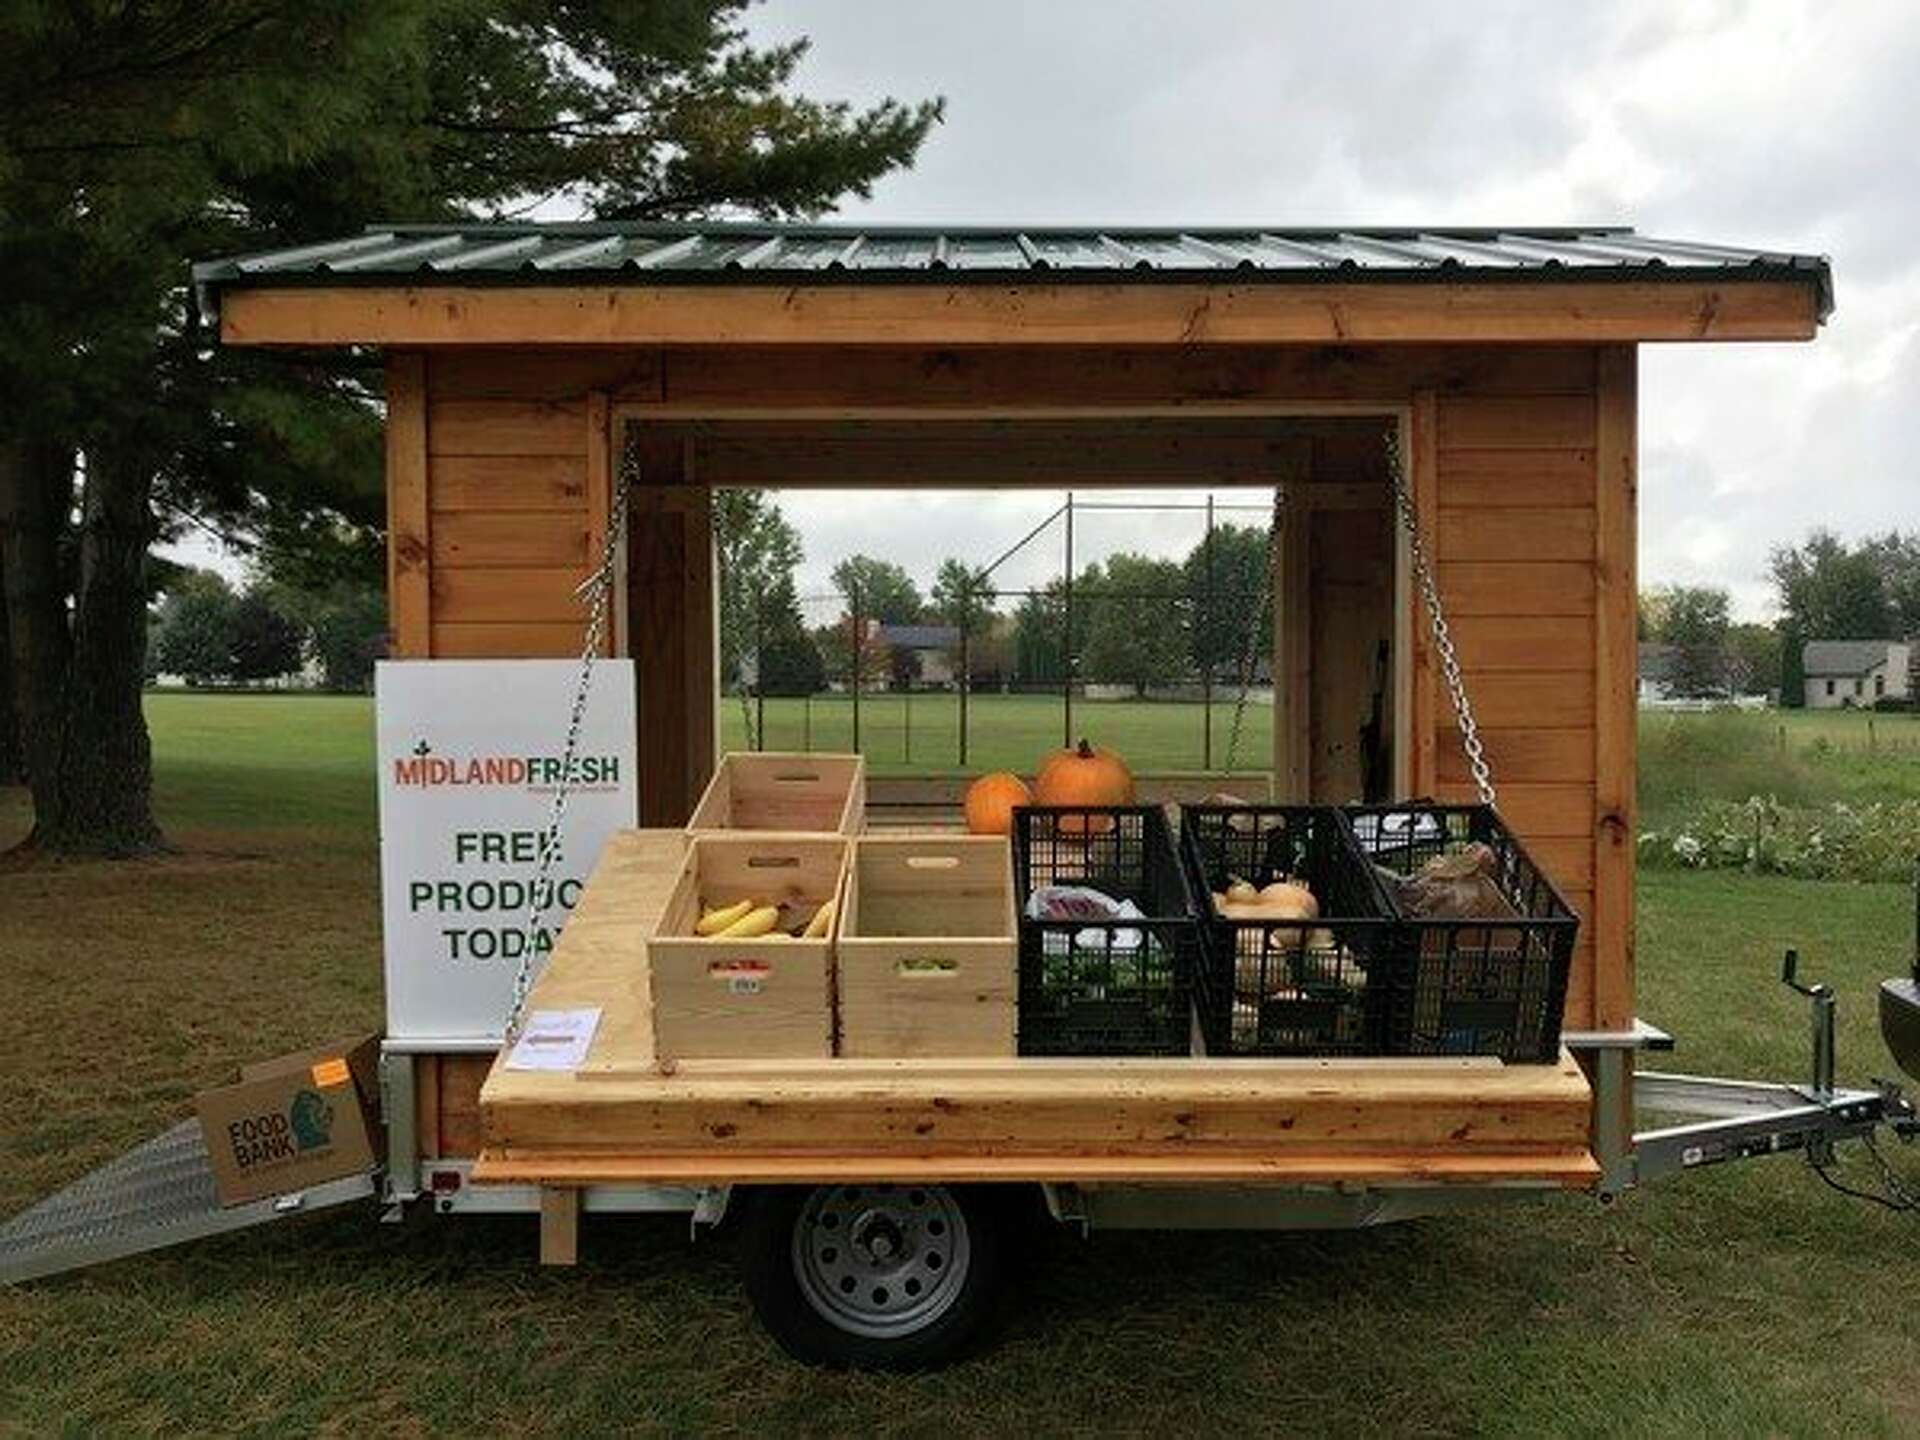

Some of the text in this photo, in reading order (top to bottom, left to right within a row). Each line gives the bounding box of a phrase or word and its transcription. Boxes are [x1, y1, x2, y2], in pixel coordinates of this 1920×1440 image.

[456, 831, 563, 863] FREE
[411, 879, 584, 912] PRODUC
[443, 927, 562, 959] TODA
[228, 1112, 289, 1146] FOOD
[234, 1135, 296, 1169] BANK
